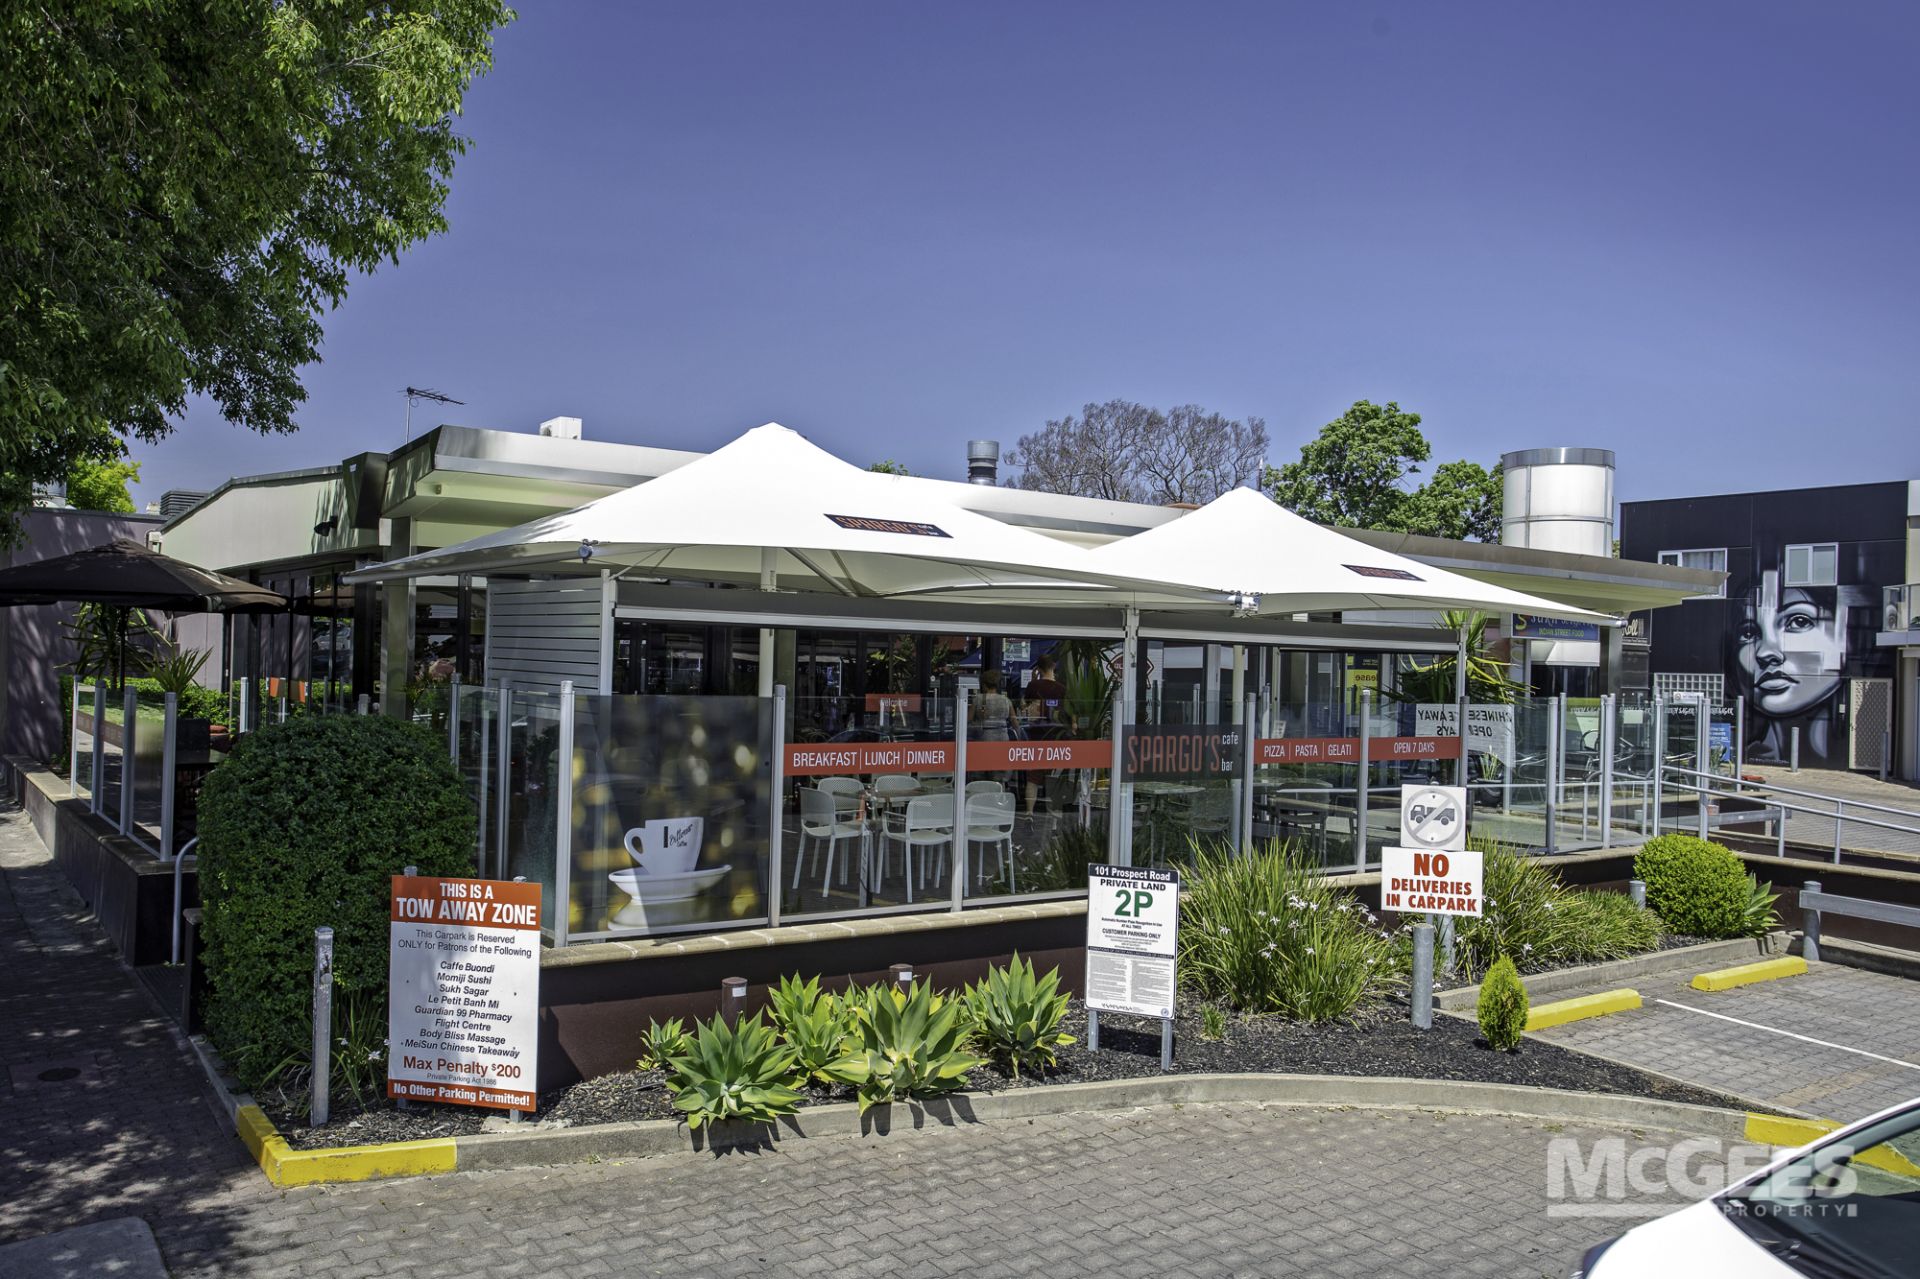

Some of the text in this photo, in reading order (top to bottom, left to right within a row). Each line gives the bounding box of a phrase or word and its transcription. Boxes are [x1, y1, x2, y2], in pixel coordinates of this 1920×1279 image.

[1222, 731, 1239, 745] cafe
[1008, 746, 1072, 762] OPEN 7 DAYS
[1127, 735, 1220, 774] SPARGO'S
[1264, 744, 1352, 757] PIZZA PASTA GELATI
[1393, 742, 1435, 754] OPEN 7 DAYS
[792, 750, 945, 768] BREAKFAST LUNCH DINNER
[1221, 757, 1233, 772] bar
[1095, 865, 1171, 881] 101 Prospect Road
[1413, 853, 1450, 878] NO
[440, 882, 494, 900] THIS IS A
[1100, 878, 1166, 891] PRIVATE LAND
[1391, 878, 1472, 896] DELIVERIES
[1114, 889, 1153, 918] 2P
[1386, 893, 1477, 912] IN CARPARK
[396, 897, 537, 926] TOW AWAY ZONE
[416, 929, 515, 944] This Carpark is Reserved
[1102, 927, 1127, 936] CUSTOMER
[1127, 929, 1148, 938] PARKING
[398, 939, 532, 959] ONLY for Patrons of the Following
[440, 960, 495, 973] Caffe Buondi
[436, 972, 492, 985] Momiji Sushi
[439, 983, 489, 997] Sukh Sagar
[428, 994, 500, 1009] Le Petit Banh Mi
[414, 1005, 513, 1024] Guardian 99 Pharmacy
[435, 1018, 492, 1032] Flight Centre
[419, 1028, 506, 1046] Body Bliss Massage
[404, 1039, 520, 1059] MeiSun Chinese Takeaway
[403, 1055, 521, 1079] Max Penalty $200
[426, 1072, 448, 1081] Private
[448, 1074, 471, 1084] Parking
[393, 1082, 530, 1106] No Other Parking Permitted!
